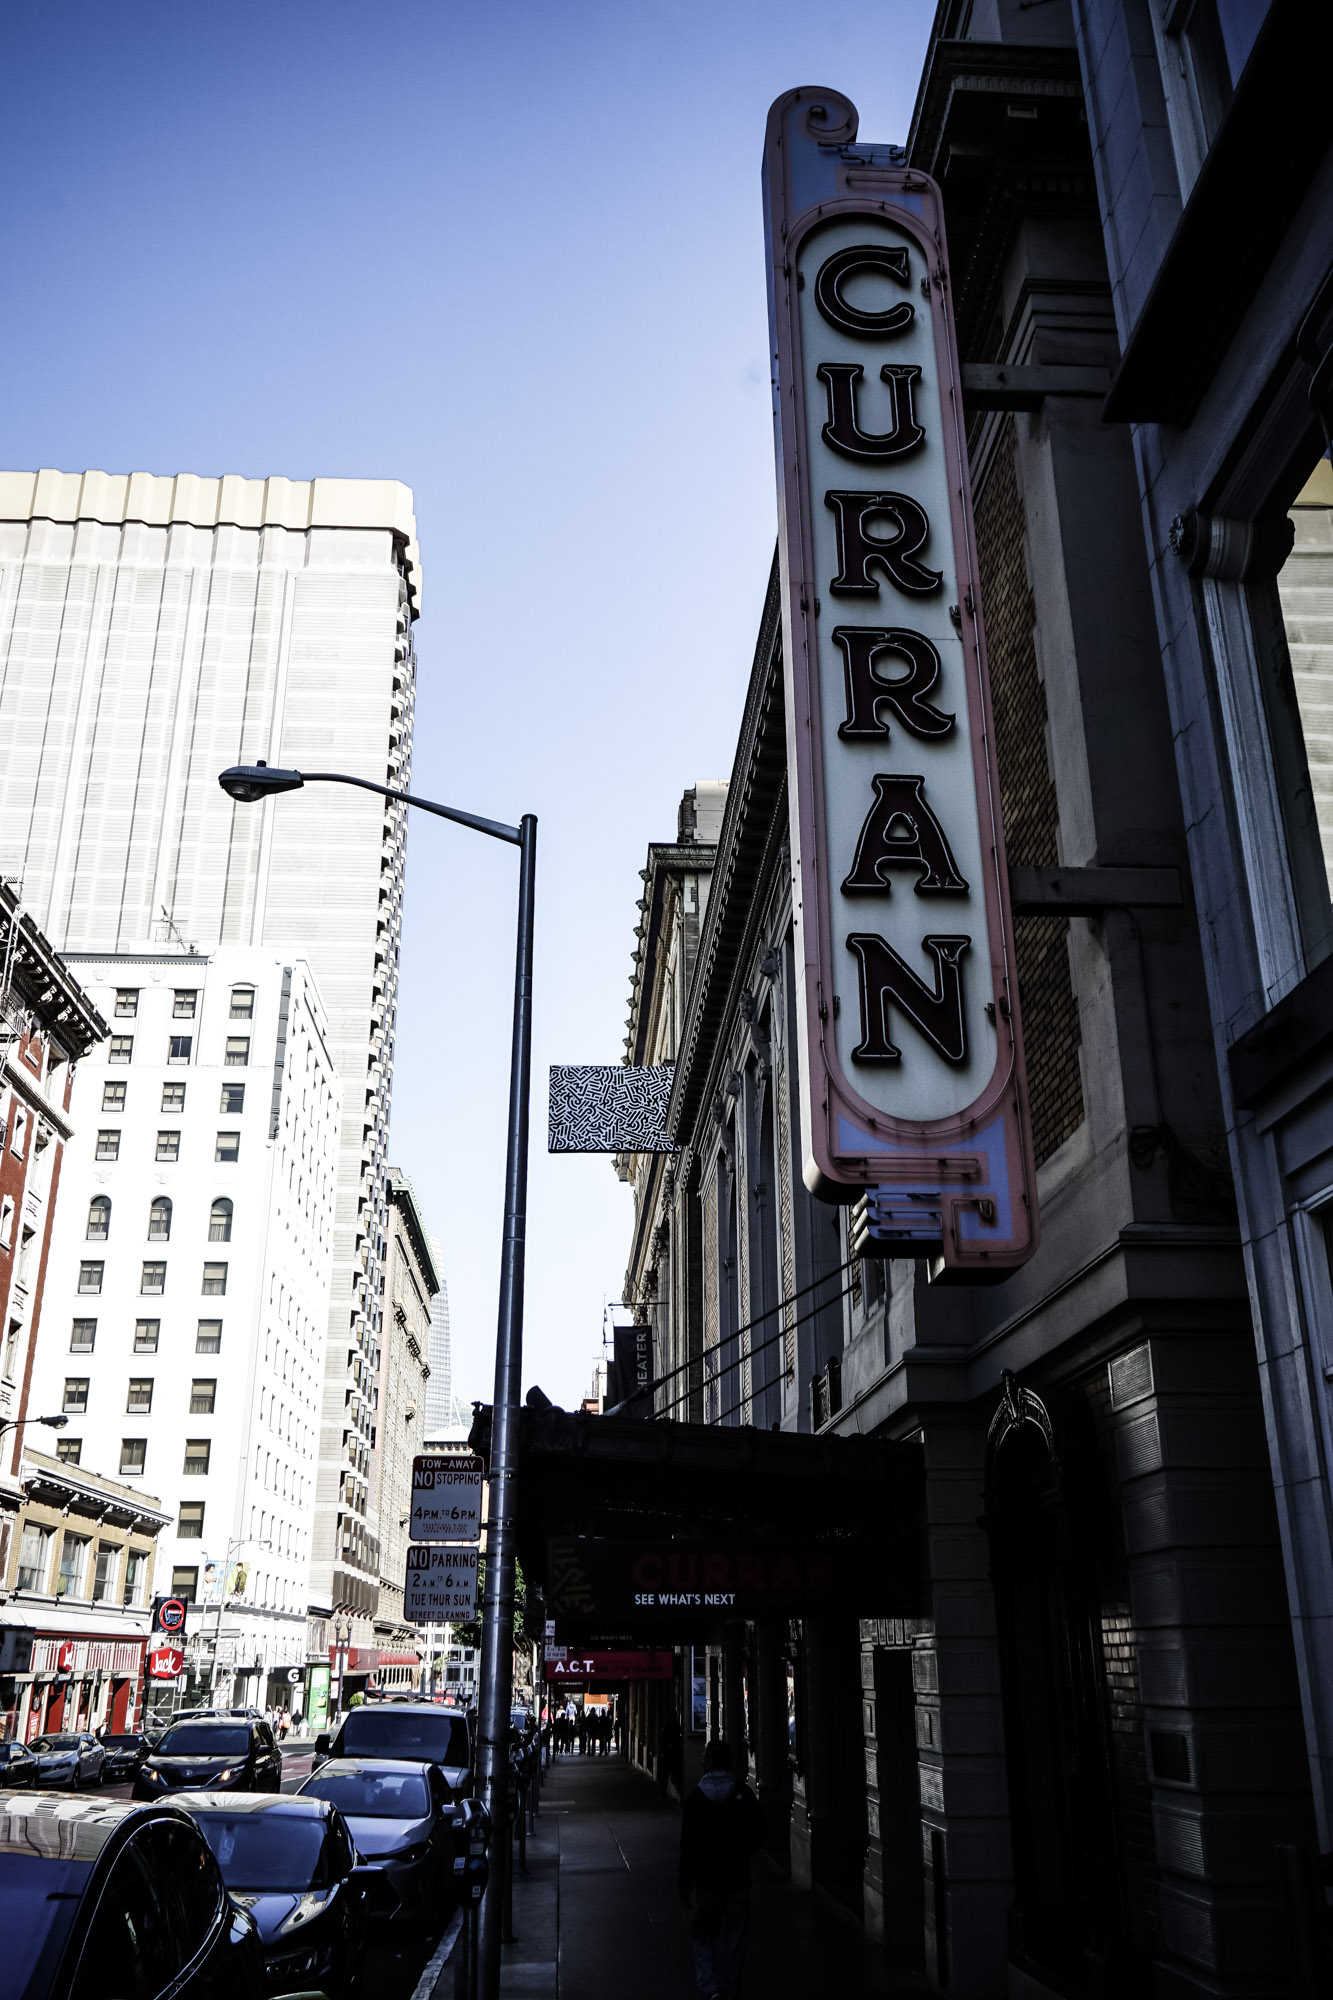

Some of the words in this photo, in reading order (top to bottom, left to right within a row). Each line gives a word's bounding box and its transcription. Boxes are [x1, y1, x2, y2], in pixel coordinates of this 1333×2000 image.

[815, 244, 971, 1067] CURRAN
[636, 1332, 649, 1391] HEATER
[421, 1459, 476, 1469] TOW-AWAY
[414, 1471, 433, 1487] NO
[436, 1473, 480, 1486] STOPPING
[409, 1549, 428, 1568] NO
[431, 1553, 476, 1568] PARKING
[410, 1593, 427, 1606] TUE
[429, 1593, 451, 1606] THUR
[453, 1593, 471, 1606] SUN
[634, 1593, 655, 1606] SEE
[658, 1592, 702, 1606] WHAT'S
[705, 1593, 736, 1606] NEXT
[410, 1611, 435, 1620] STREET
[437, 1611, 470, 1620] CLEANING
[151, 1651, 182, 1675] Jack
[554, 1660, 595, 1673] A.C.T.
